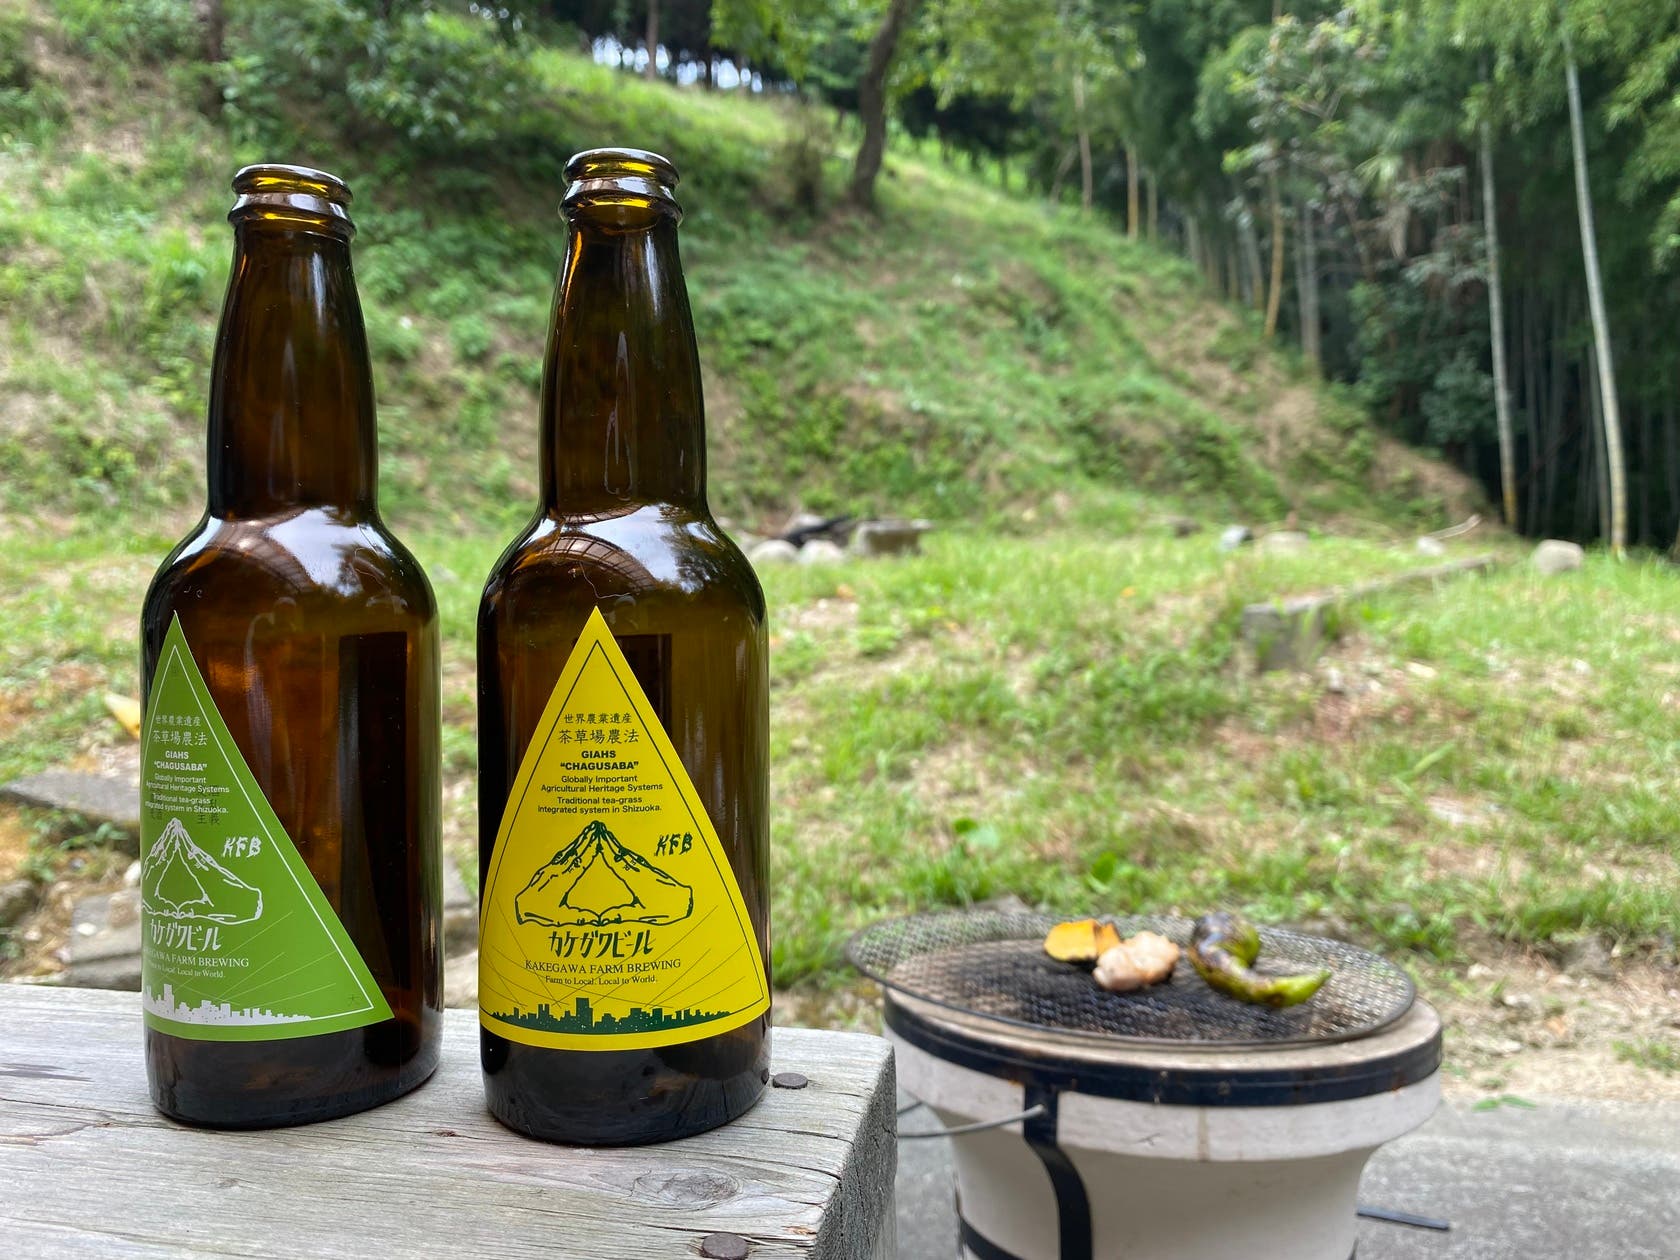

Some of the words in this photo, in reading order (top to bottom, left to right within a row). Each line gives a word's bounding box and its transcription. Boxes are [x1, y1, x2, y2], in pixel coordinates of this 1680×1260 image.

[564, 712, 632, 724] 世界農業遺産
[559, 729, 639, 744] 茶草場農法
[165, 750, 189, 760] GIAHS
[581, 750, 617, 759] GIAHS
[174, 775, 206, 784] Important
[561, 776, 593, 785] Globally
[595, 775, 638, 784] Important
[197, 785, 230, 794] Systems
[541, 785, 587, 794] Agricultural
[588, 784, 625, 794] Heritage
[627, 783, 664, 793] Systems
[557, 796, 600, 805] Traditional
[602, 796, 643, 805] tea-grass
[580, 806, 610, 815] system
[612, 805, 620, 813] in
[222, 836, 262, 858] KFB
[655, 832, 693, 857] KFB
[150, 918, 222, 952] カケガワビール
[548, 929, 654, 958] カケガワビール
[171, 953, 196, 966] FARM
[198, 957, 250, 968] BREWING
[525, 960, 587, 974] KAKEGAWA
[590, 964, 624, 974] FARM
[627, 958, 681, 974] BREWING
[545, 975, 563, 984] Farm
[598, 977, 620, 985] Local
